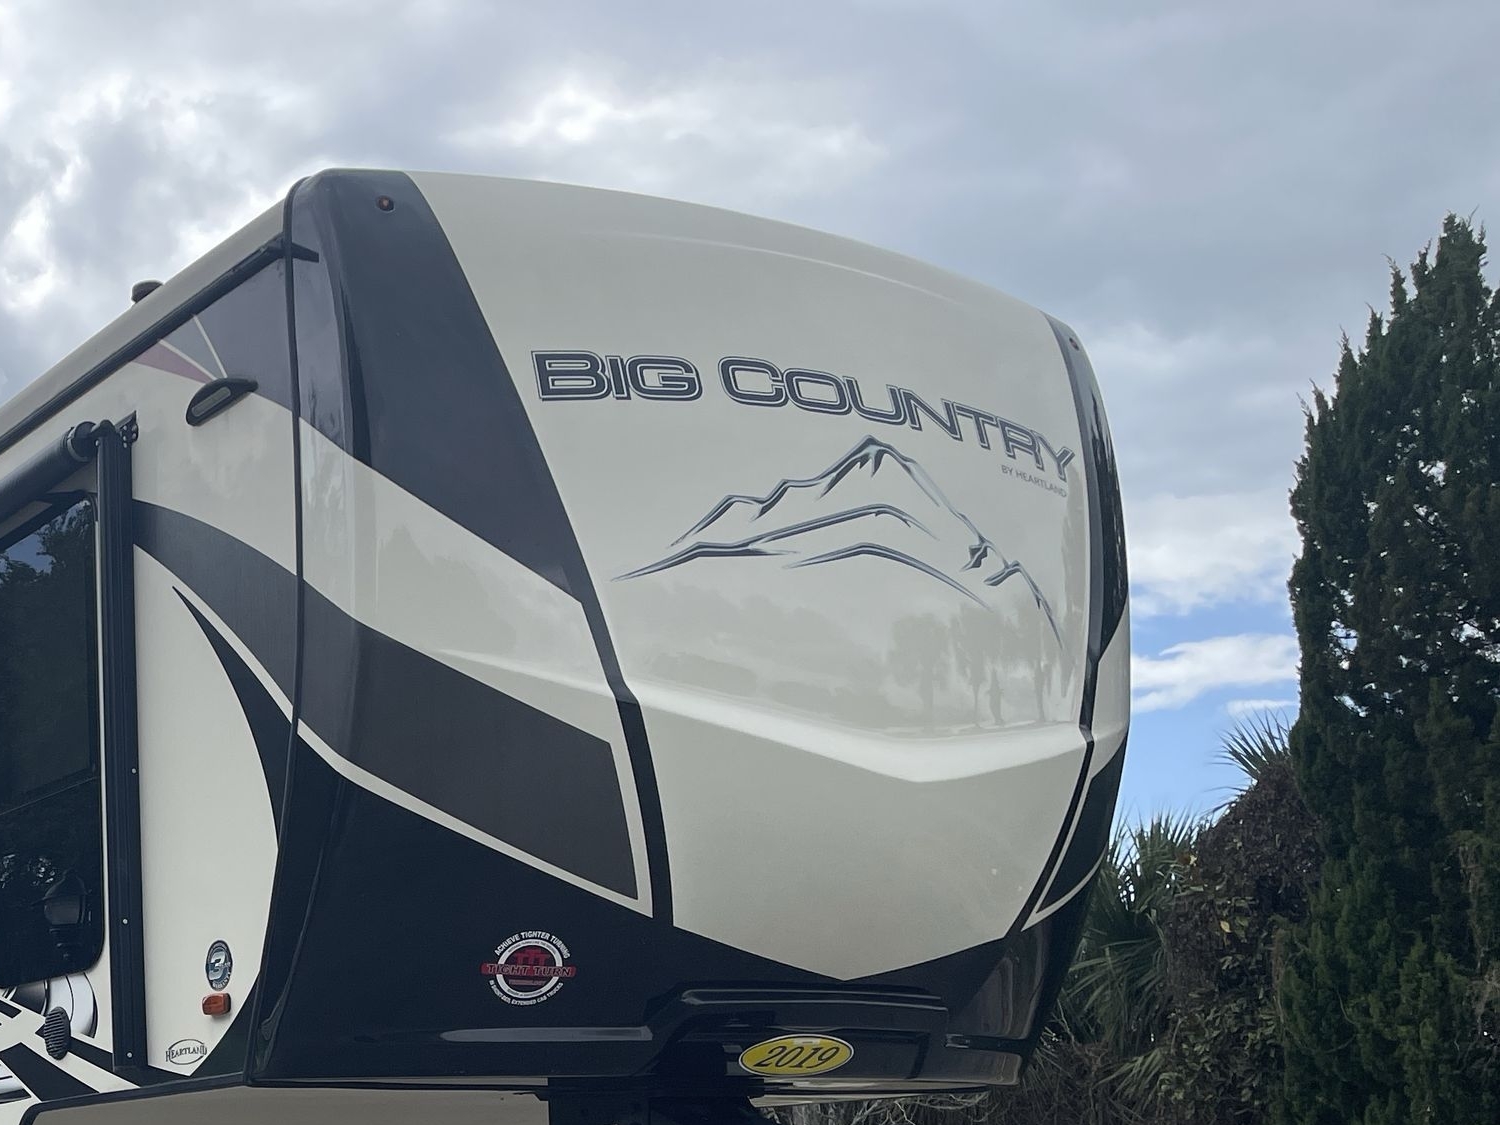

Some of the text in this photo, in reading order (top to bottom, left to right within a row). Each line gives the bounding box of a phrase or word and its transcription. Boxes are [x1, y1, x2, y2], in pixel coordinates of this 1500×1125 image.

[531, 351, 1075, 482] BIG COUNTRY
[1001, 464, 1067, 498] BY HEARTLAND
[494, 933, 521, 956] ACHIEVE
[520, 930, 551, 941] TIGHTER
[550, 935, 571, 959] TURNING
[209, 951, 226, 981] 3
[486, 963, 573, 977] TIGHT TURN
[165, 1045, 207, 1062] HEARTLAND
[753, 1045, 840, 1069] 2019
